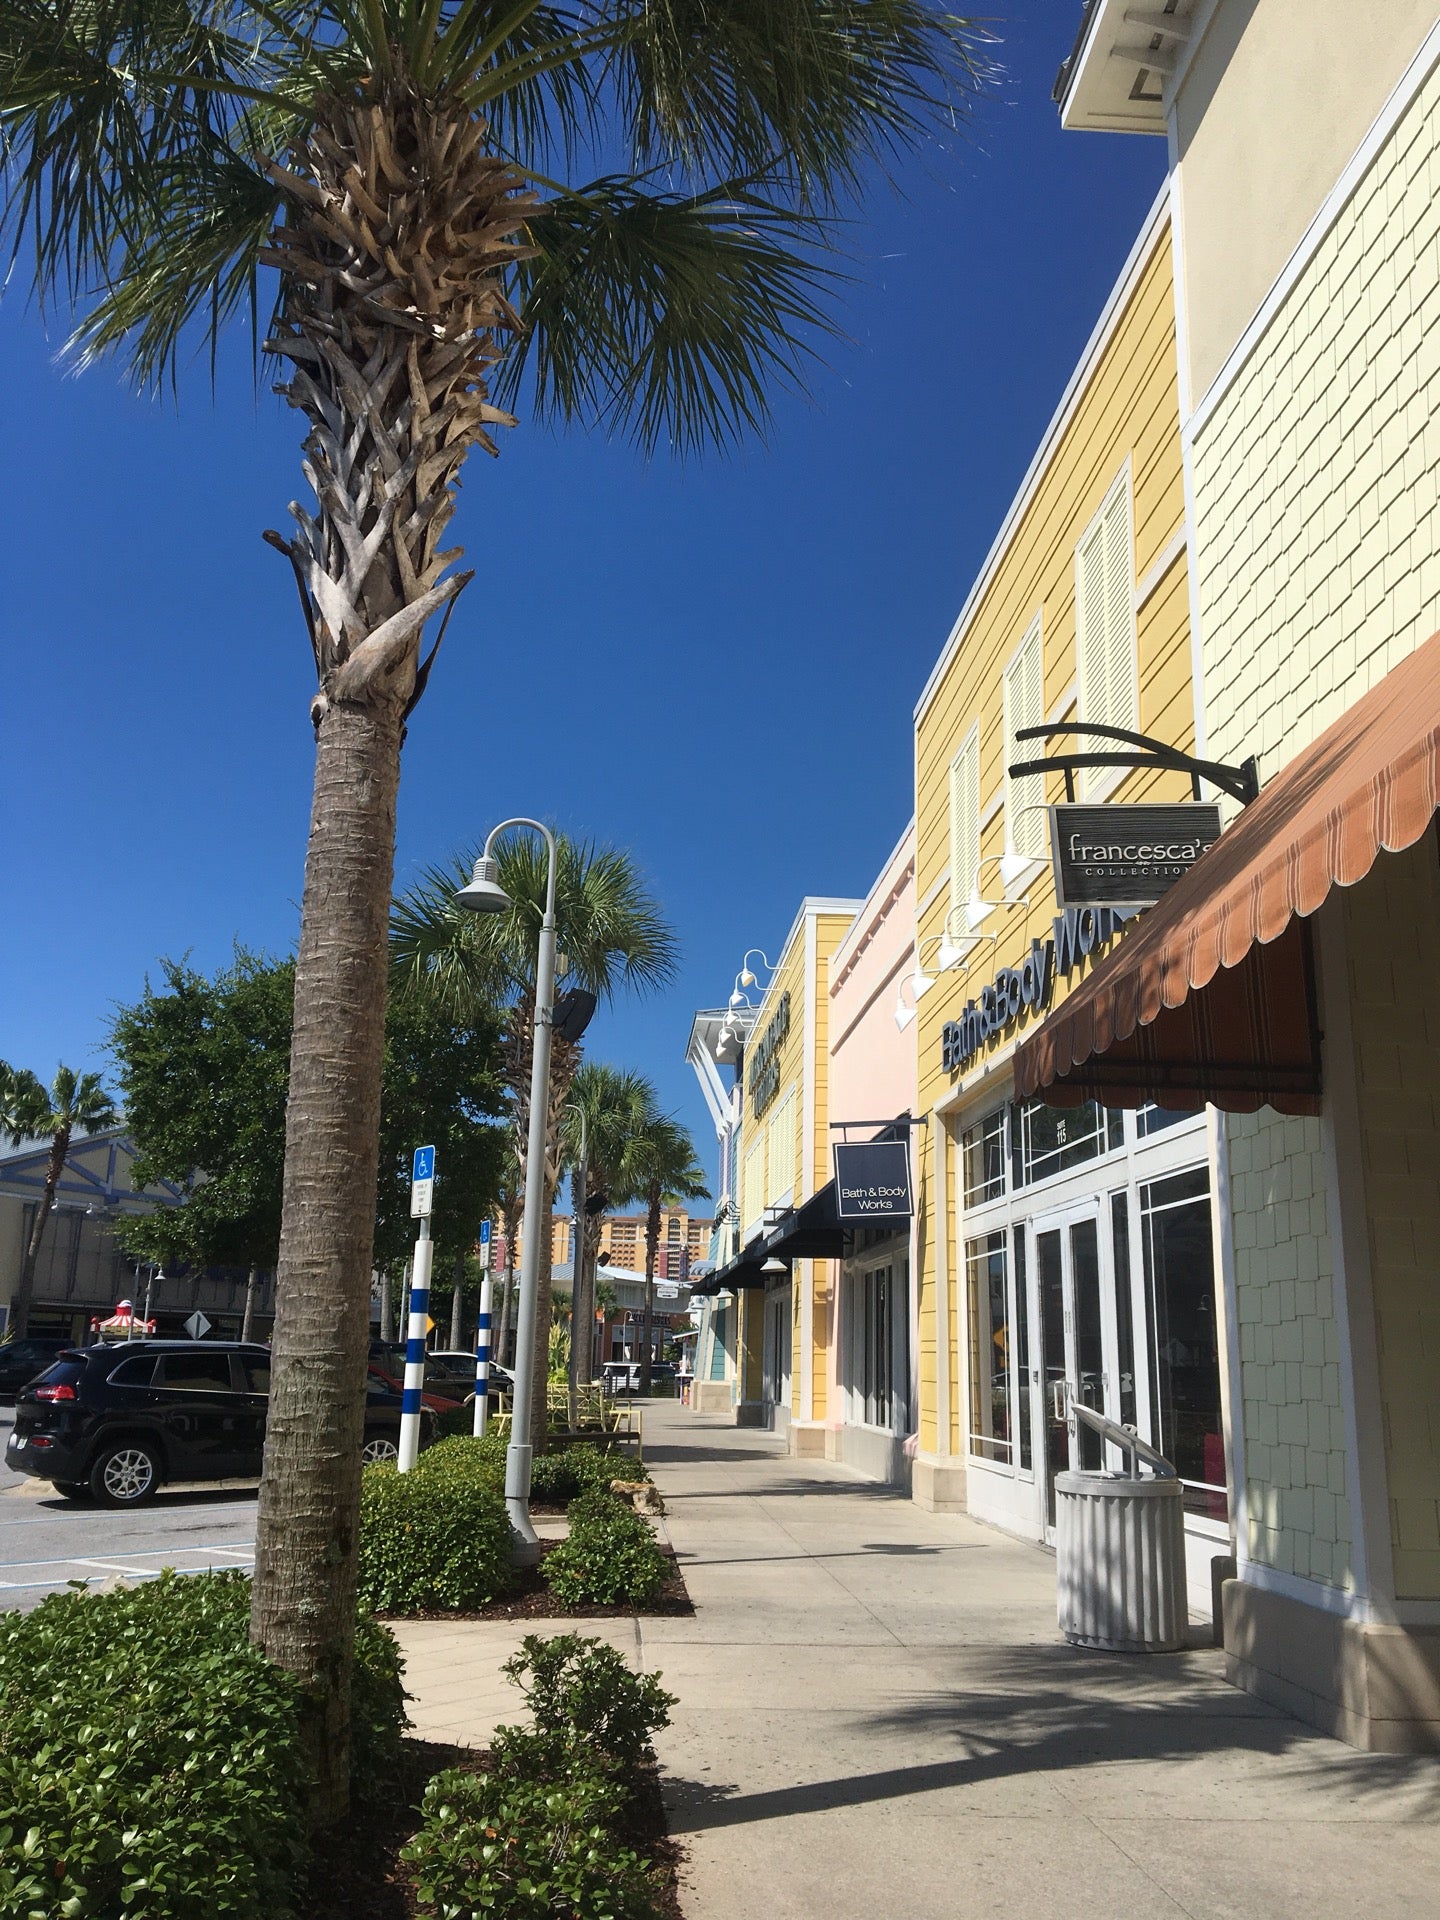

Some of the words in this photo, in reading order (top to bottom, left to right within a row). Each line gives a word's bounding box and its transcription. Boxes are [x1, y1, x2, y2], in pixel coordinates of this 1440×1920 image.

[1057, 1128, 1067, 1145] 115
[842, 1187, 868, 1199] Bath
[868, 1187, 877, 1197] &
[878, 1186, 906, 1198] Body
[858, 1200, 893, 1210] Works
